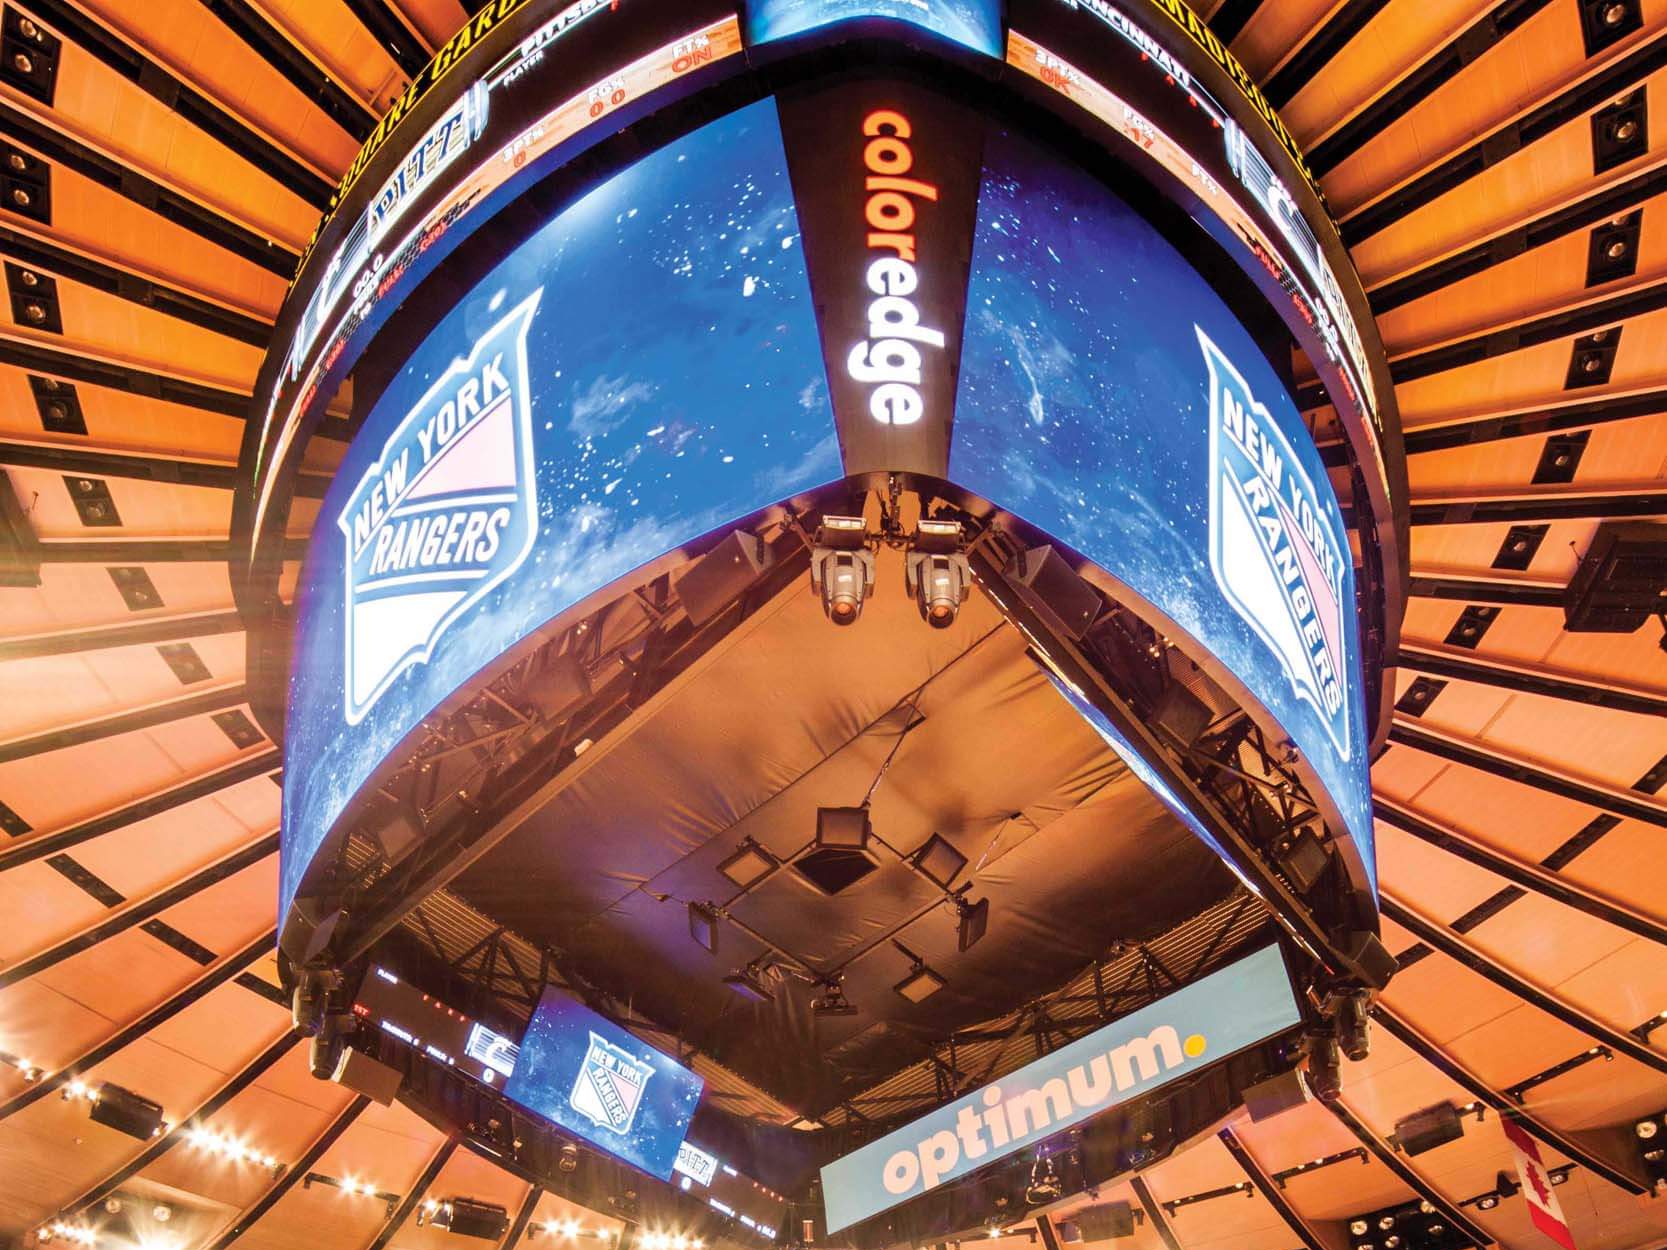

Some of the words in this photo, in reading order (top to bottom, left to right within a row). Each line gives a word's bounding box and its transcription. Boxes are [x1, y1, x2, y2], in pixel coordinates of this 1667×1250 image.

[501, 50, 544, 86] PLAYER
[847, 109, 944, 426] coloredge
[354, 456, 408, 540] NEW
[417, 351, 511, 468] YORK
[1223, 387, 1286, 484] NEW
[1289, 472, 1339, 588] YORK
[369, 508, 510, 575] RANGERS
[1243, 475, 1342, 719] RANGERS
[591, 1044, 617, 1070] NEW
[615, 1059, 643, 1085] YORK
[592, 1067, 627, 1124] RANGERS
